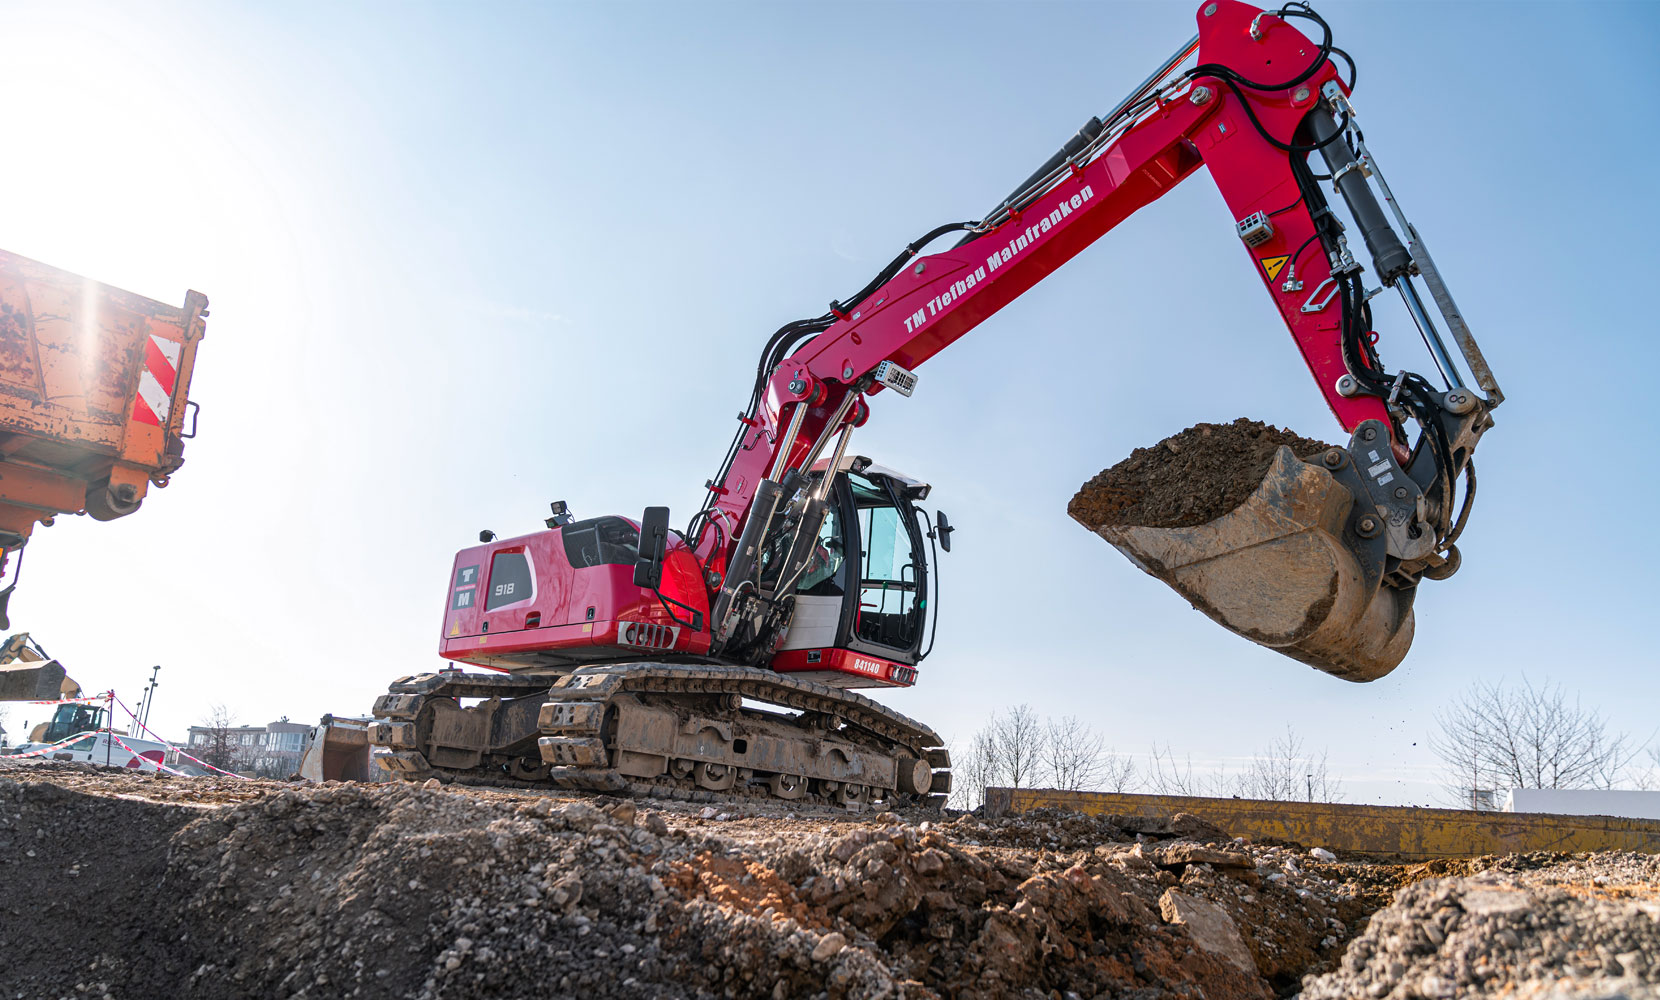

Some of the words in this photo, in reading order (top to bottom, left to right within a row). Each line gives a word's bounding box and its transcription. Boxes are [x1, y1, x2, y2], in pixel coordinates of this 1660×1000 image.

[903, 308, 927, 334] TM
[926, 265, 987, 317] Tiefbau
[986, 185, 1094, 273] Mainfranken
[462, 568, 474, 582] T
[495, 583, 515, 596] 918
[457, 592, 470, 606] M
[854, 658, 880, 673] 841140
